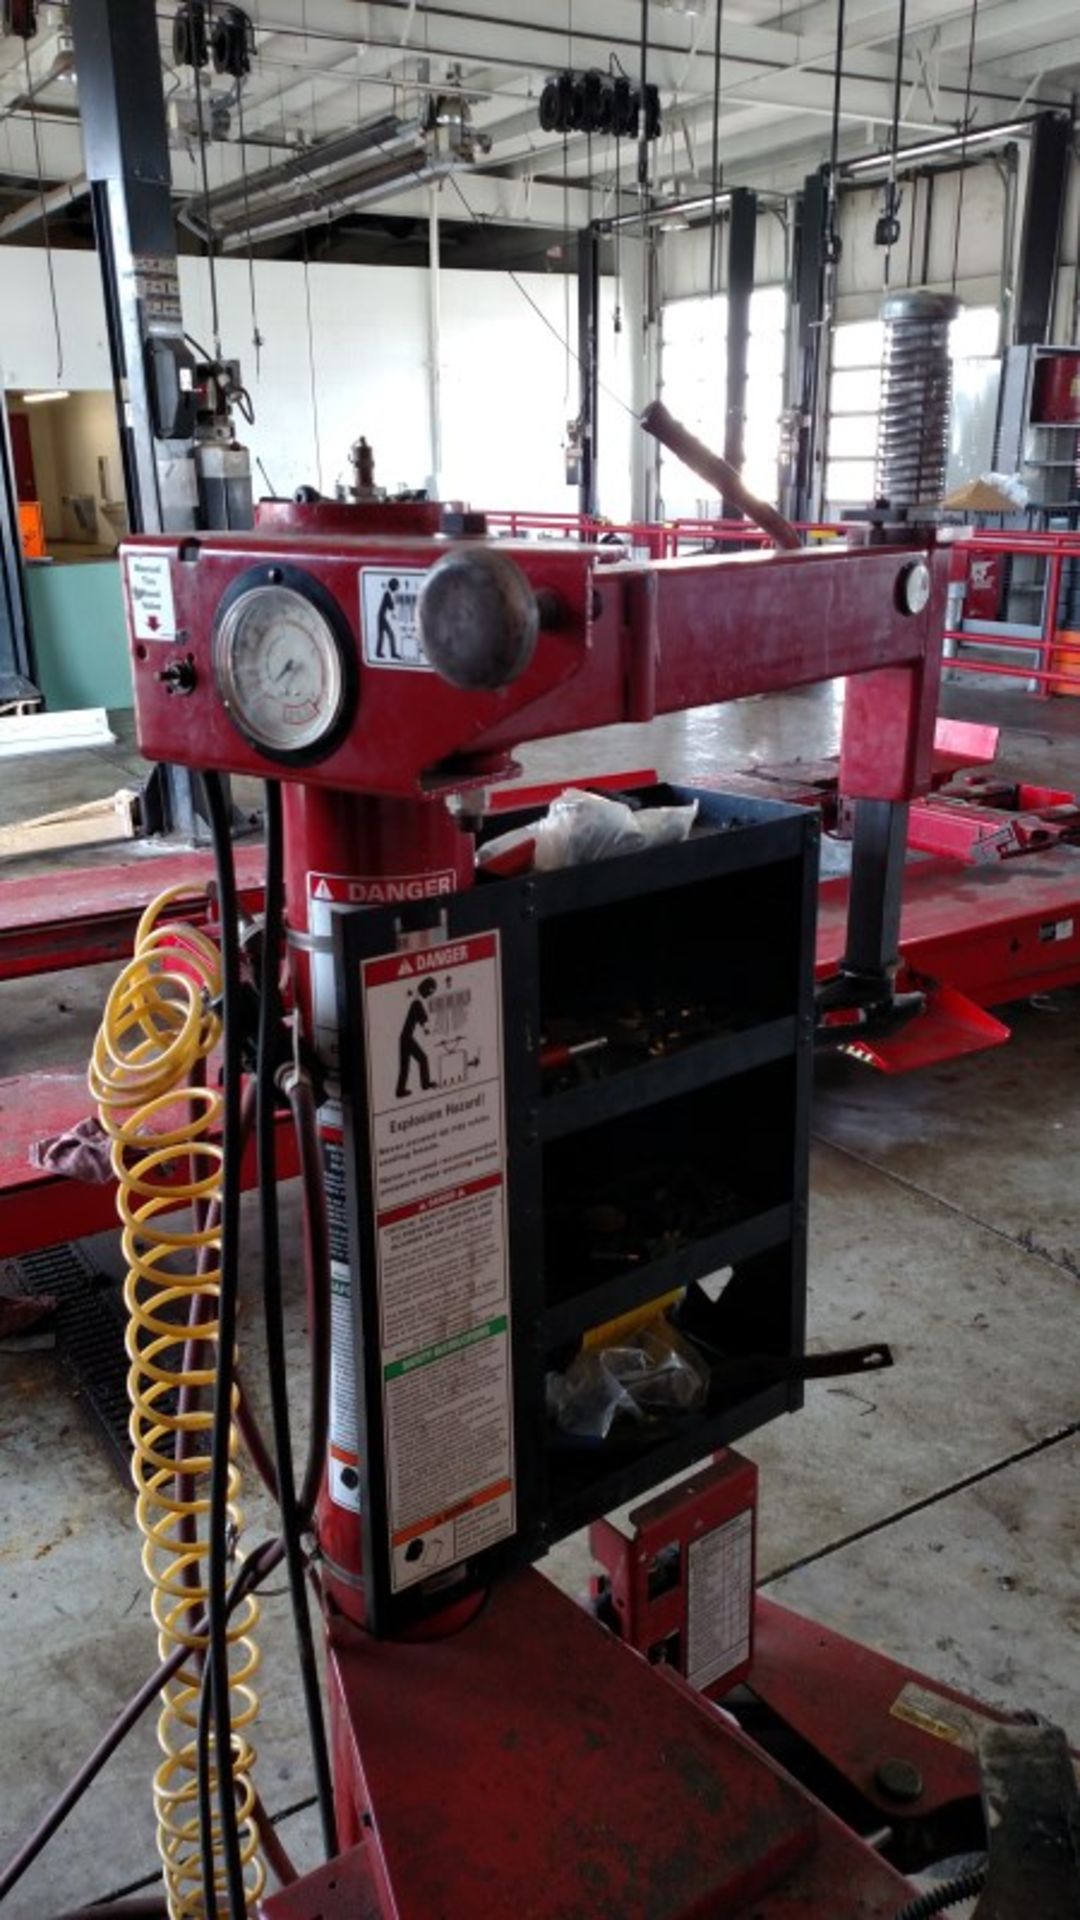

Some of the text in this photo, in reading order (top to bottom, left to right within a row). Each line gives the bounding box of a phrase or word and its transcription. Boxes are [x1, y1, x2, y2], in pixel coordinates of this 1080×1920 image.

[348, 876, 450, 901] DANGER
[416, 945, 470, 971] DANGER
[390, 1109, 442, 1133] Explosion
